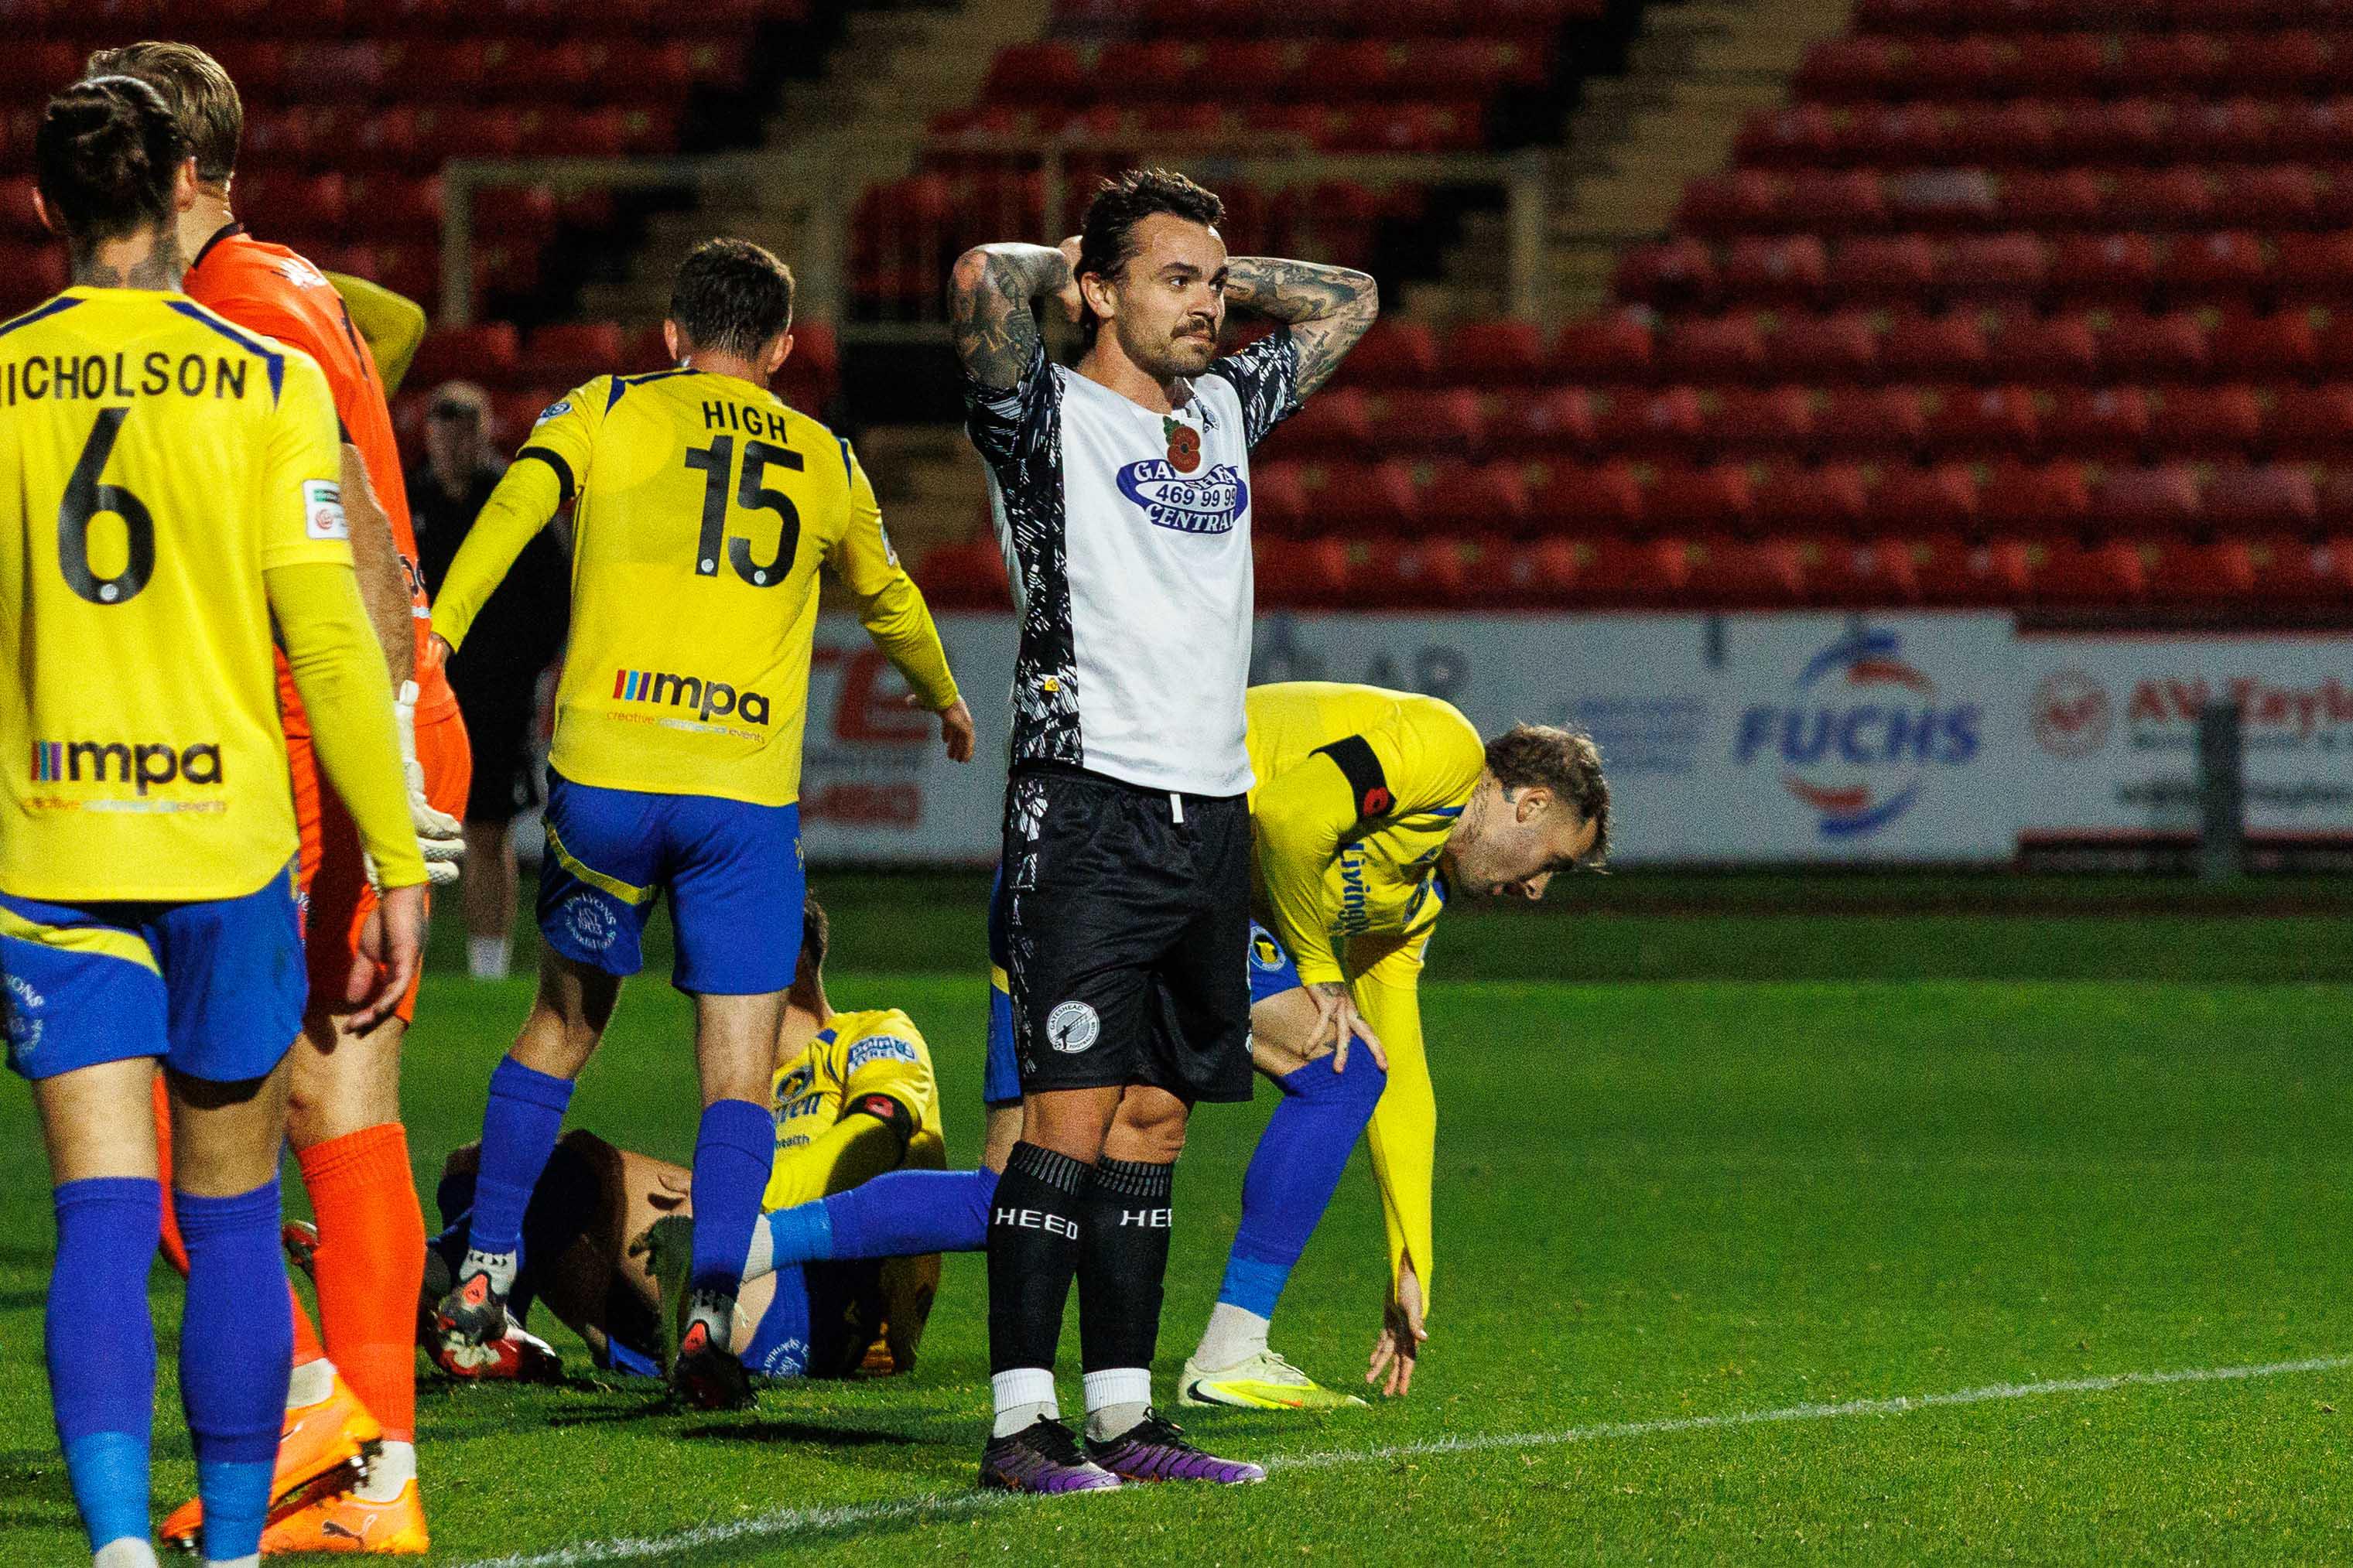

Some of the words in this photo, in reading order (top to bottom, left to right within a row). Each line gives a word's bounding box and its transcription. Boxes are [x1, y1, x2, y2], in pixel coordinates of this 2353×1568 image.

[0, 352, 246, 405] ICHOLSON
[702, 401, 788, 444] HIGH
[58, 407, 156, 604] 6
[684, 435, 805, 588] 15
[1156, 483, 1195, 504] 469
[1201, 489, 1220, 507] 99
[652, 672, 769, 726] mpa
[1736, 702, 1983, 764] FUCHS
[67, 741, 222, 795] mpa
[995, 1208, 1078, 1240] HEED
